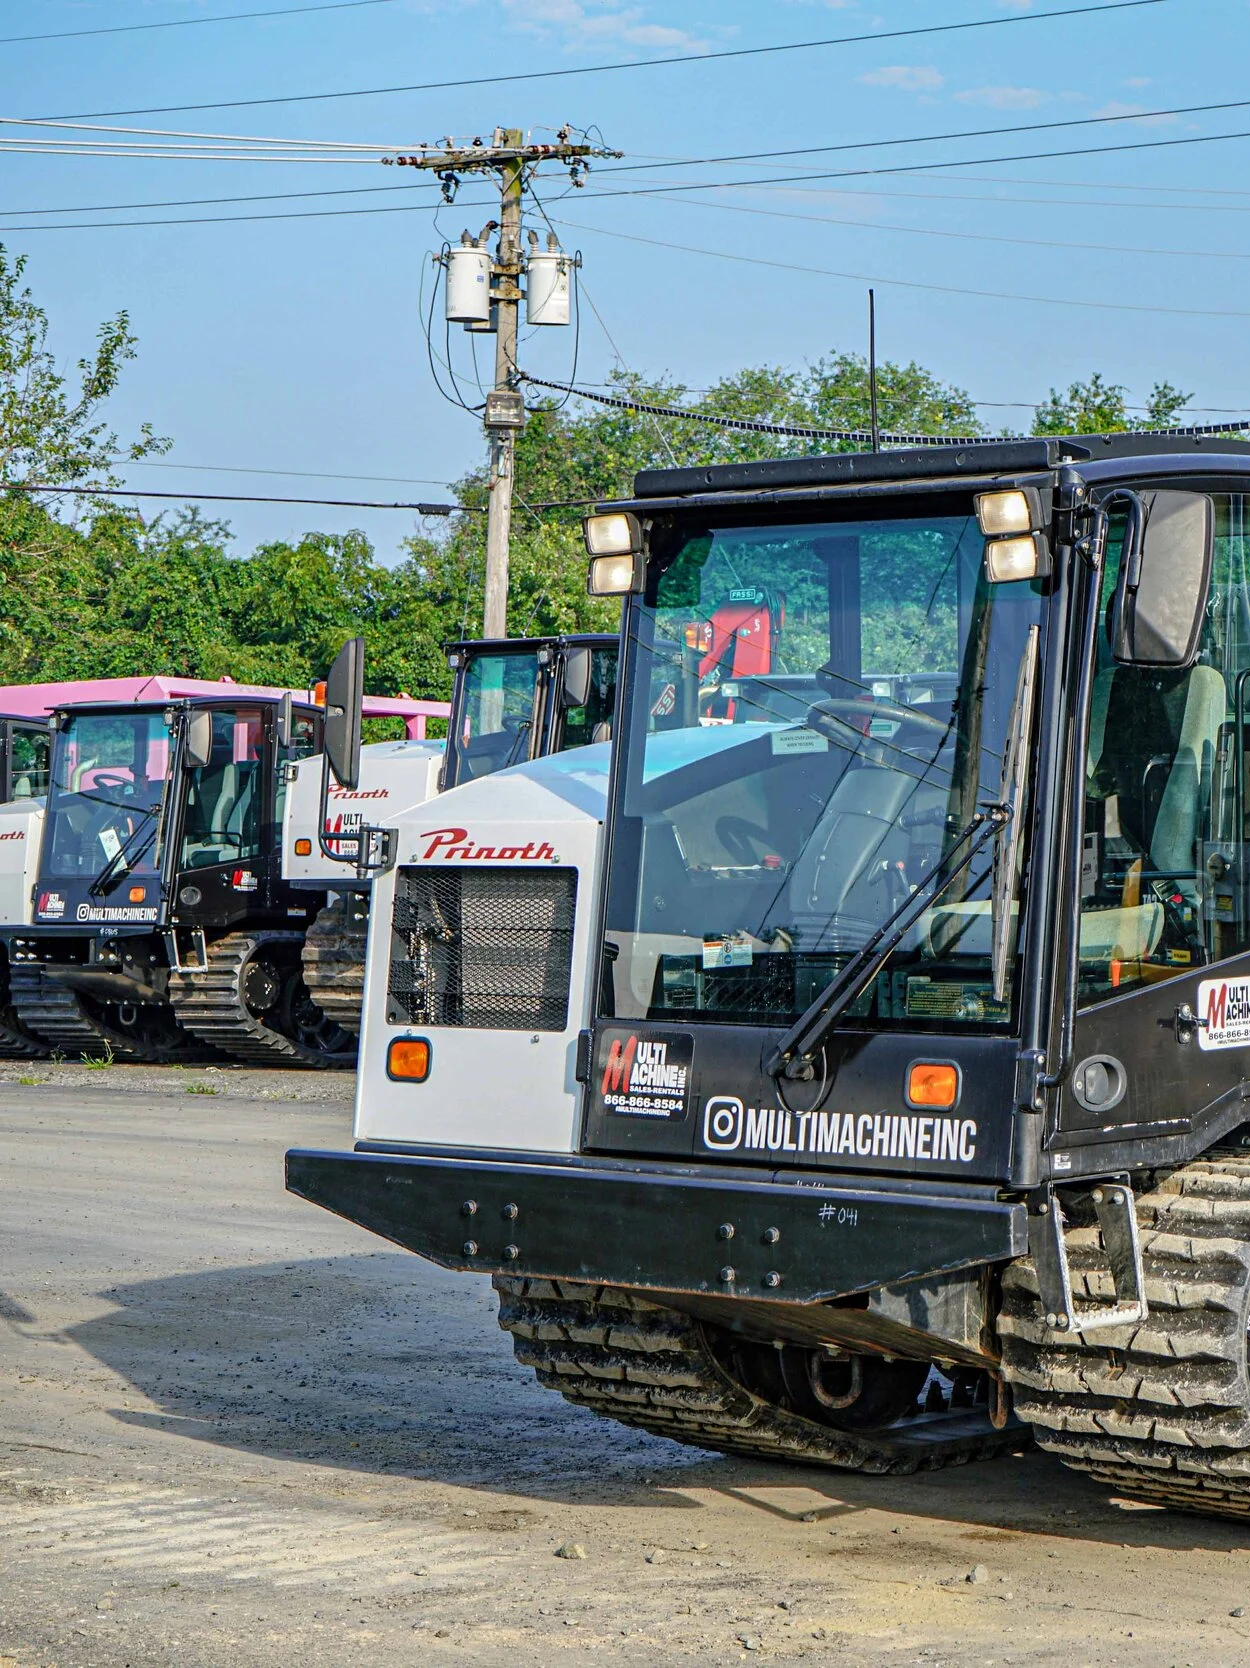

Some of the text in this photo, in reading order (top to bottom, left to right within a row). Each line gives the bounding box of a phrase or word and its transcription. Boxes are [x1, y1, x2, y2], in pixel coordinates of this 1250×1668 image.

[732, 591, 754, 599] FASSI
[420, 828, 555, 860] Prinoth
[89, 907, 158, 920] MULTIMACHINEINC
[629, 1085, 685, 1096] SALES-RENTALS
[604, 1094, 684, 1111] 866-866-8584
[745, 1108, 977, 1162] MULTIMACHINEINC
